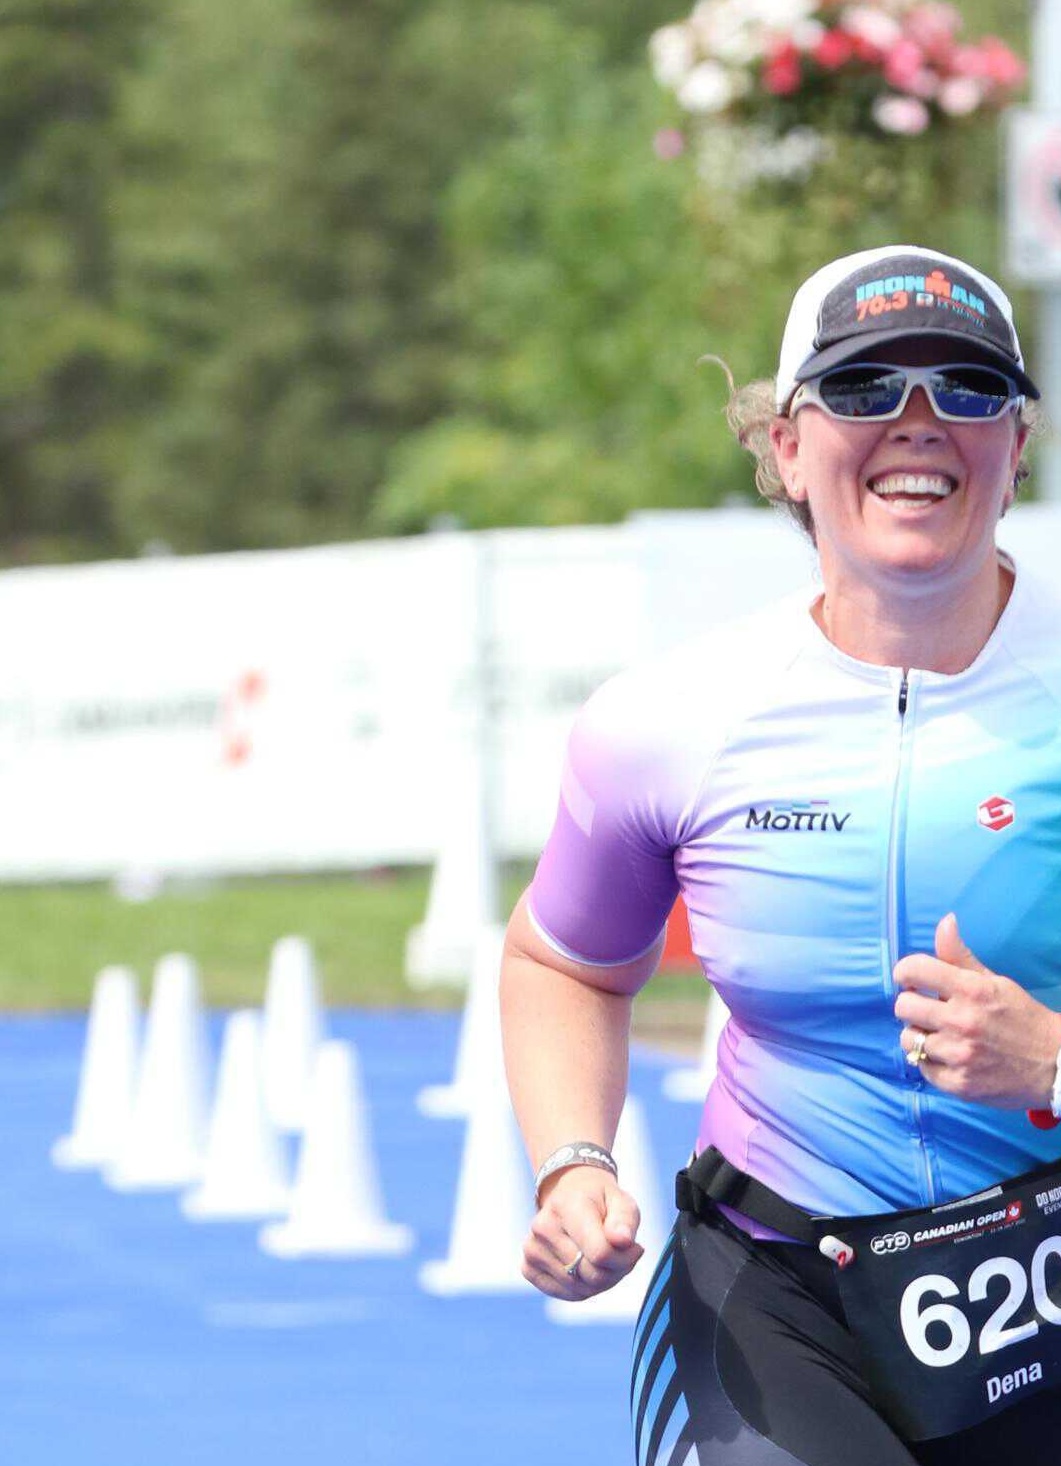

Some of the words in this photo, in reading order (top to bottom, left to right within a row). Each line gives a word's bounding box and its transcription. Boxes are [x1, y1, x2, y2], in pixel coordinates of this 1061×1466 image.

[856, 270, 986, 318] IRONMAN
[856, 291, 909, 322] 70.3
[913, 1218, 975, 1243] CANADIAN
[976, 1208, 1007, 1226] OPEN
[986, 1361, 1043, 1404] Dena
